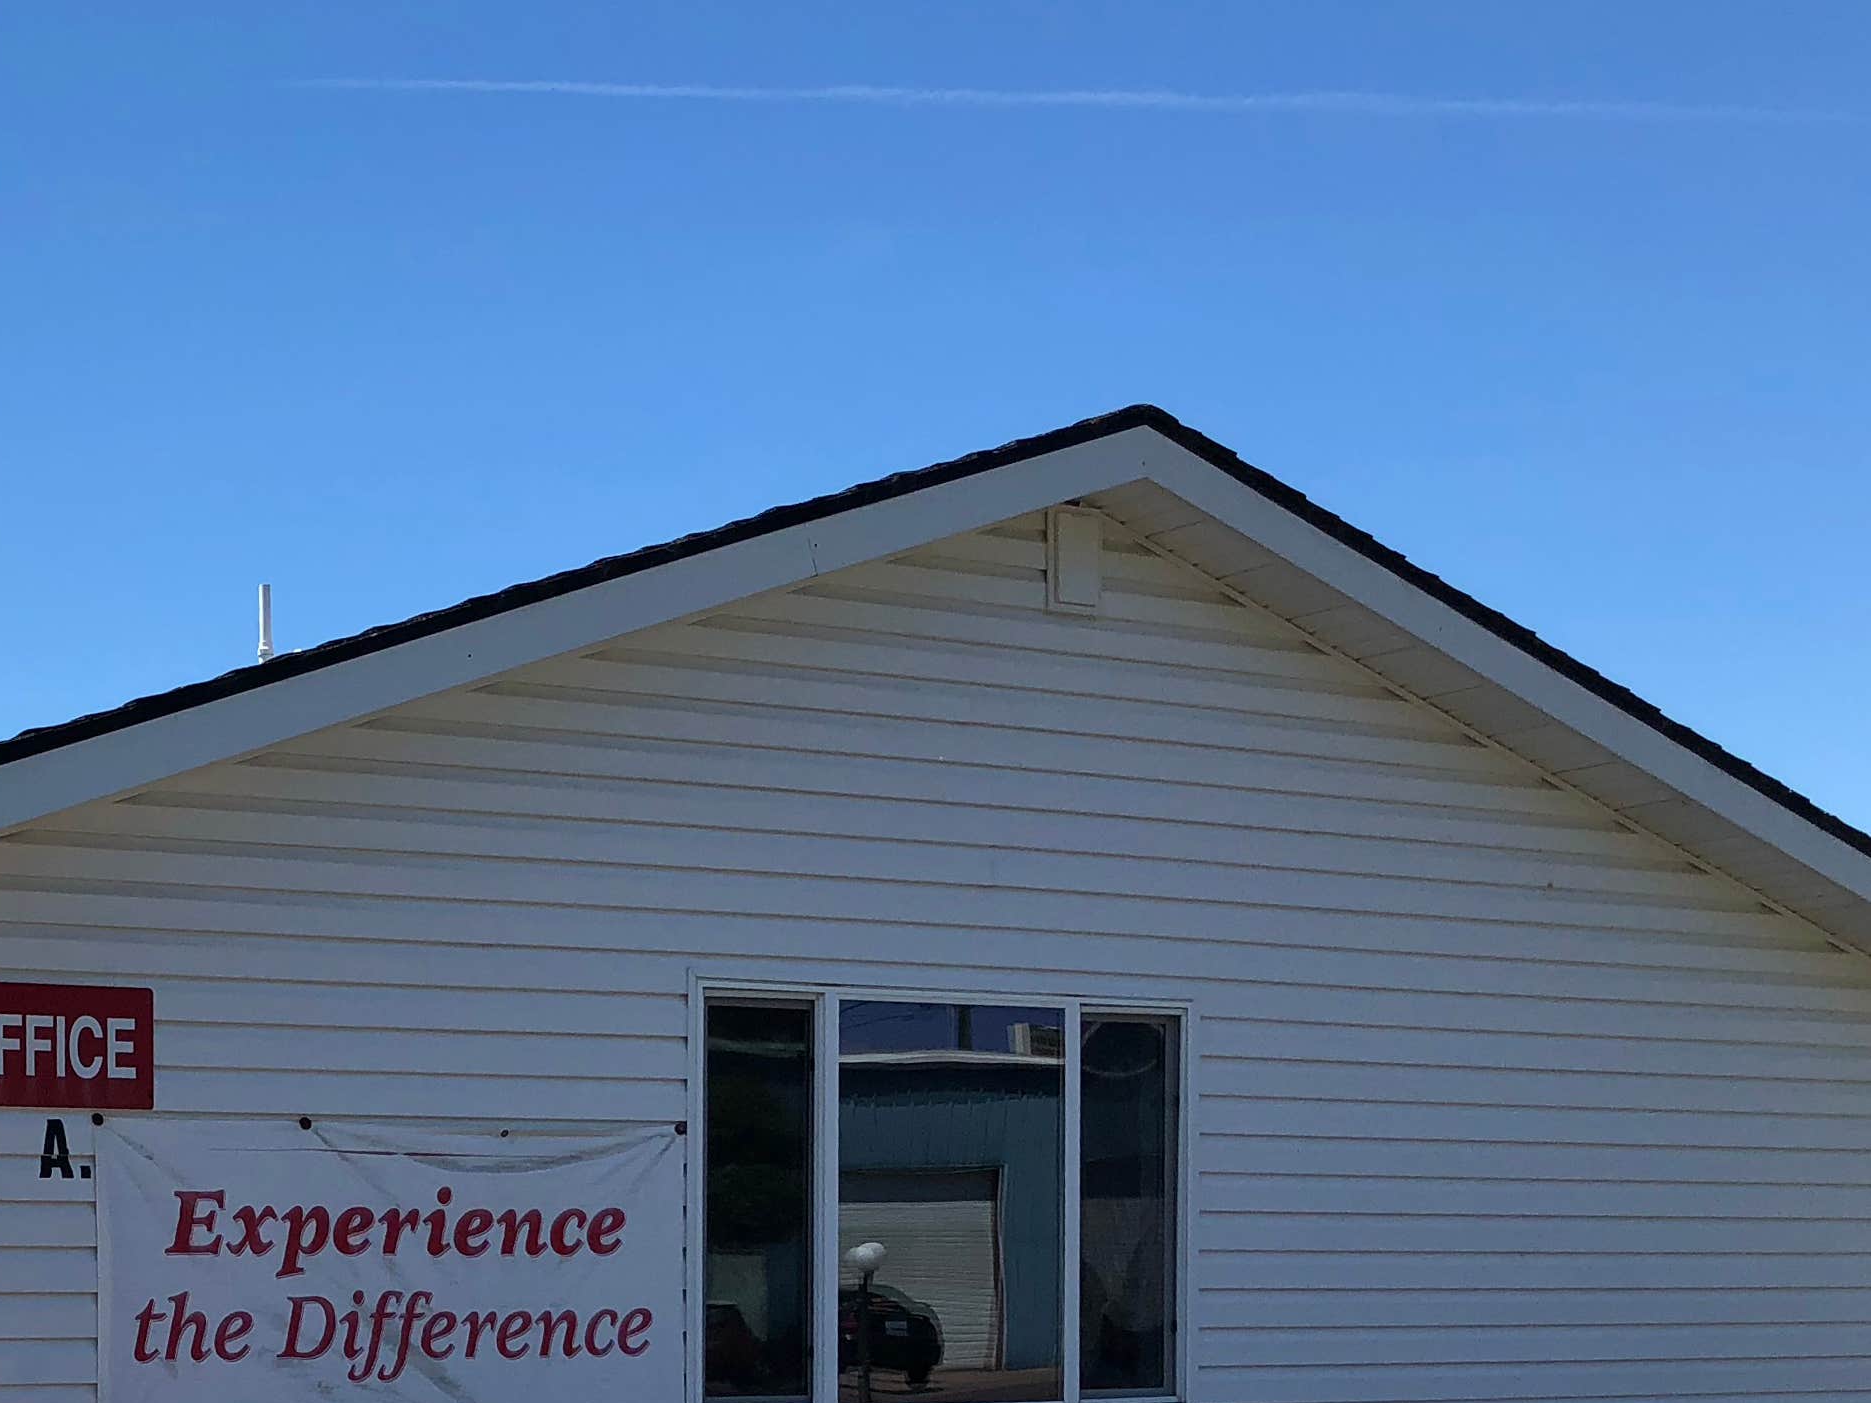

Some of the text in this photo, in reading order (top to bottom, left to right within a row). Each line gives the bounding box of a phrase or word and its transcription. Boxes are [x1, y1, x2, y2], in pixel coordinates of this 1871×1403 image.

[163, 1185, 627, 1279] Experience
[132, 1288, 655, 1384] the Difference
